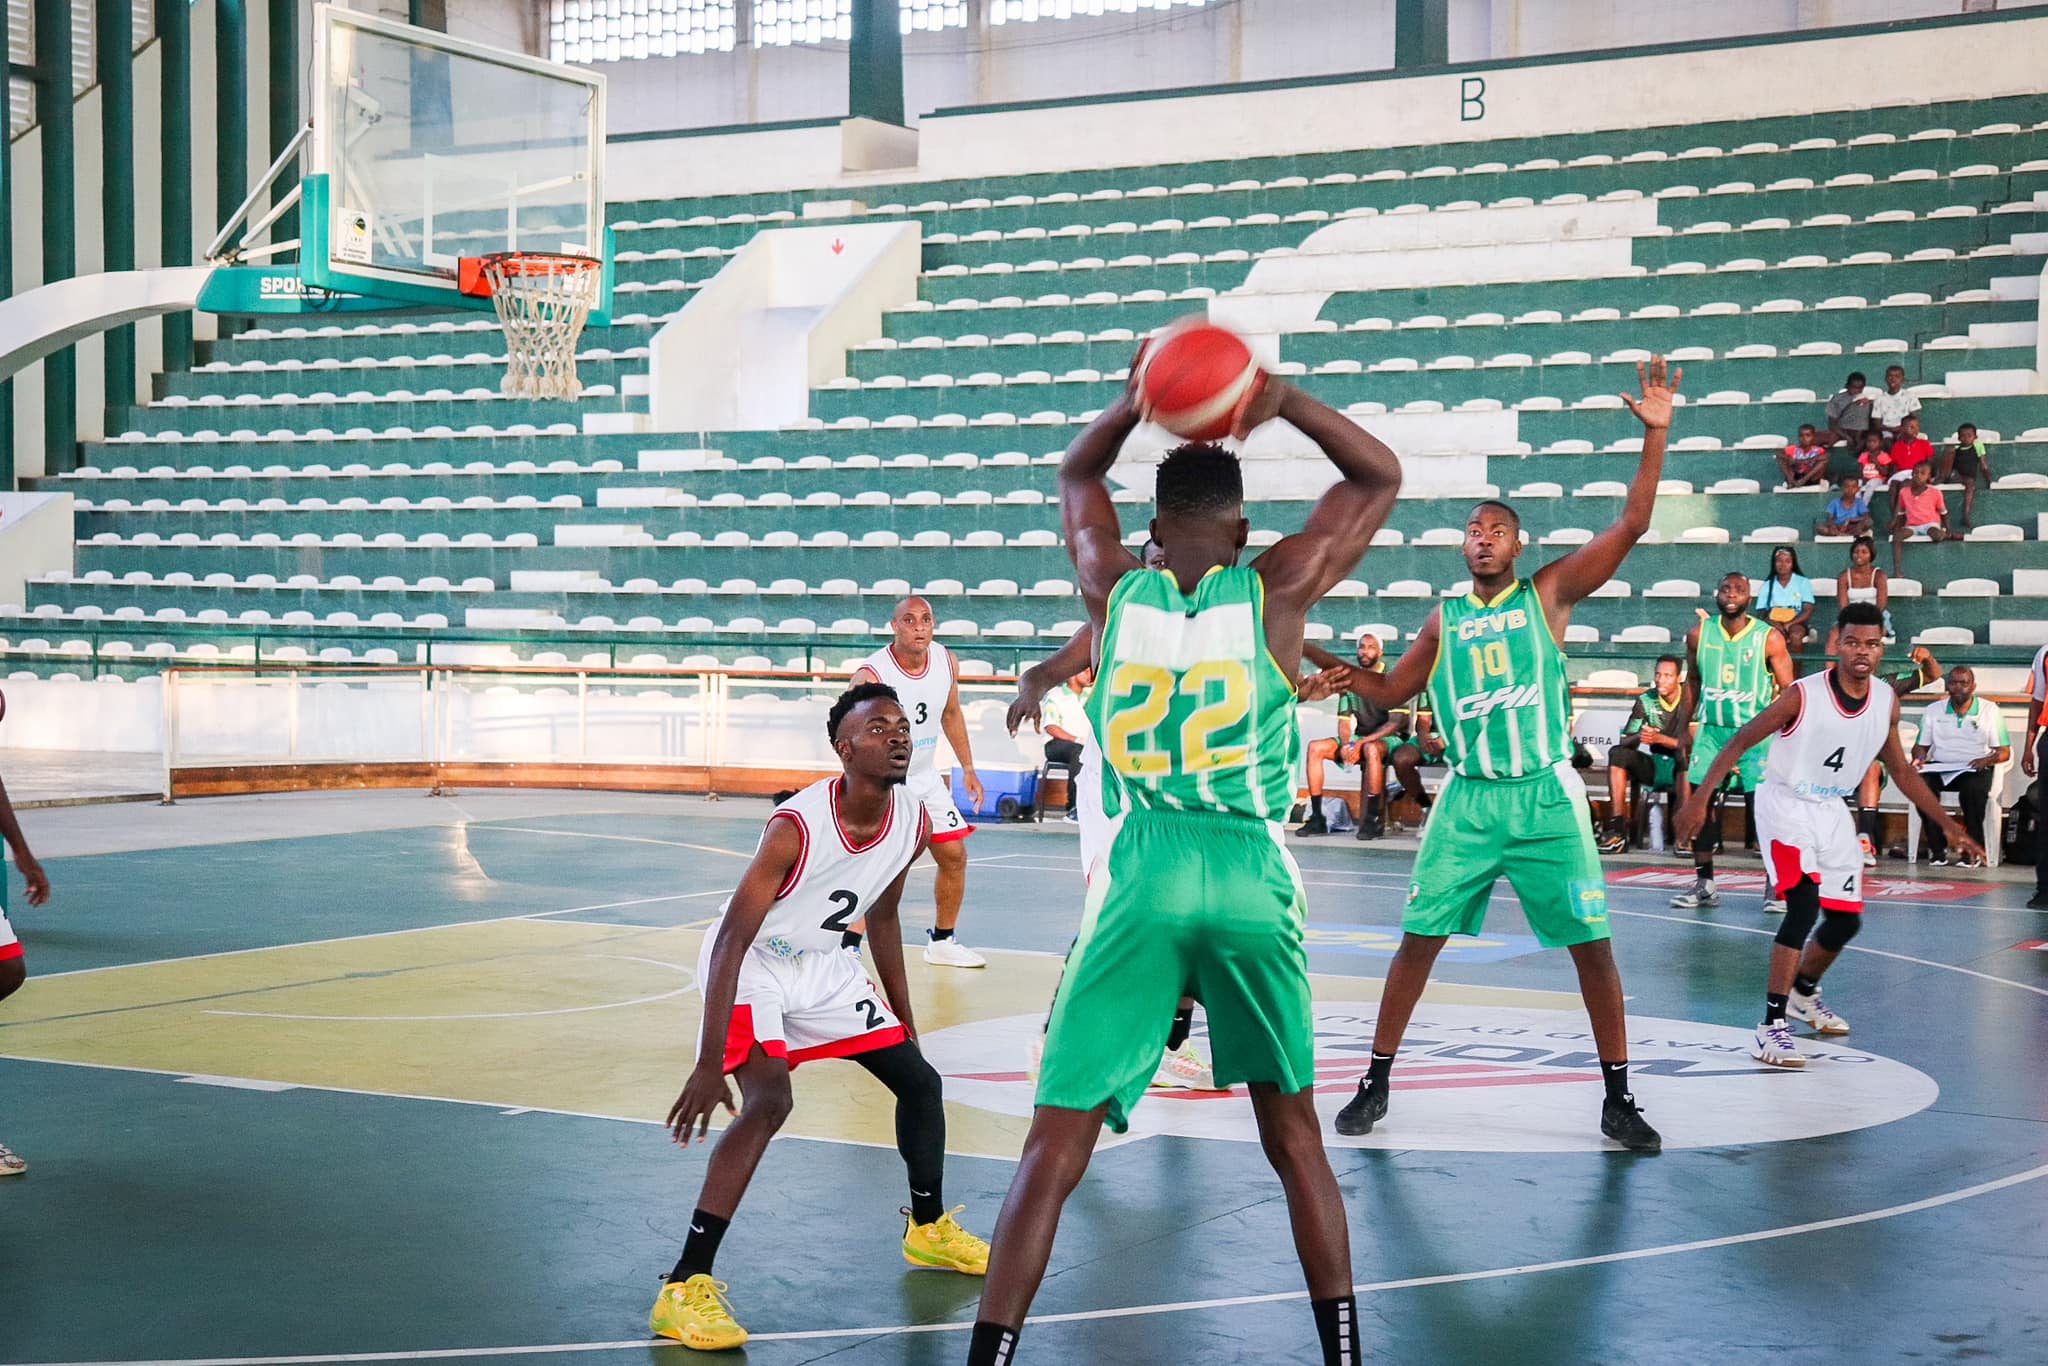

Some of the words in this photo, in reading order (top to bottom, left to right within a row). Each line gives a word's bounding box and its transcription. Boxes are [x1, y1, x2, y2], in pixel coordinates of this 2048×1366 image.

[1461, 77, 1485, 121] B
[1459, 608, 1528, 641] CFVB
[1470, 641, 1507, 679] 10
[1722, 663, 1736, 684] 6
[915, 702, 928, 725] 3
[1107, 659, 1254, 777] 22
[1582, 736, 1612, 745] BEIRA
[1823, 746, 1846, 773] 4
[947, 811, 958, 827] 3
[1843, 875, 1855, 895] 4
[820, 889, 858, 932] 2
[855, 998, 886, 1030] 2
